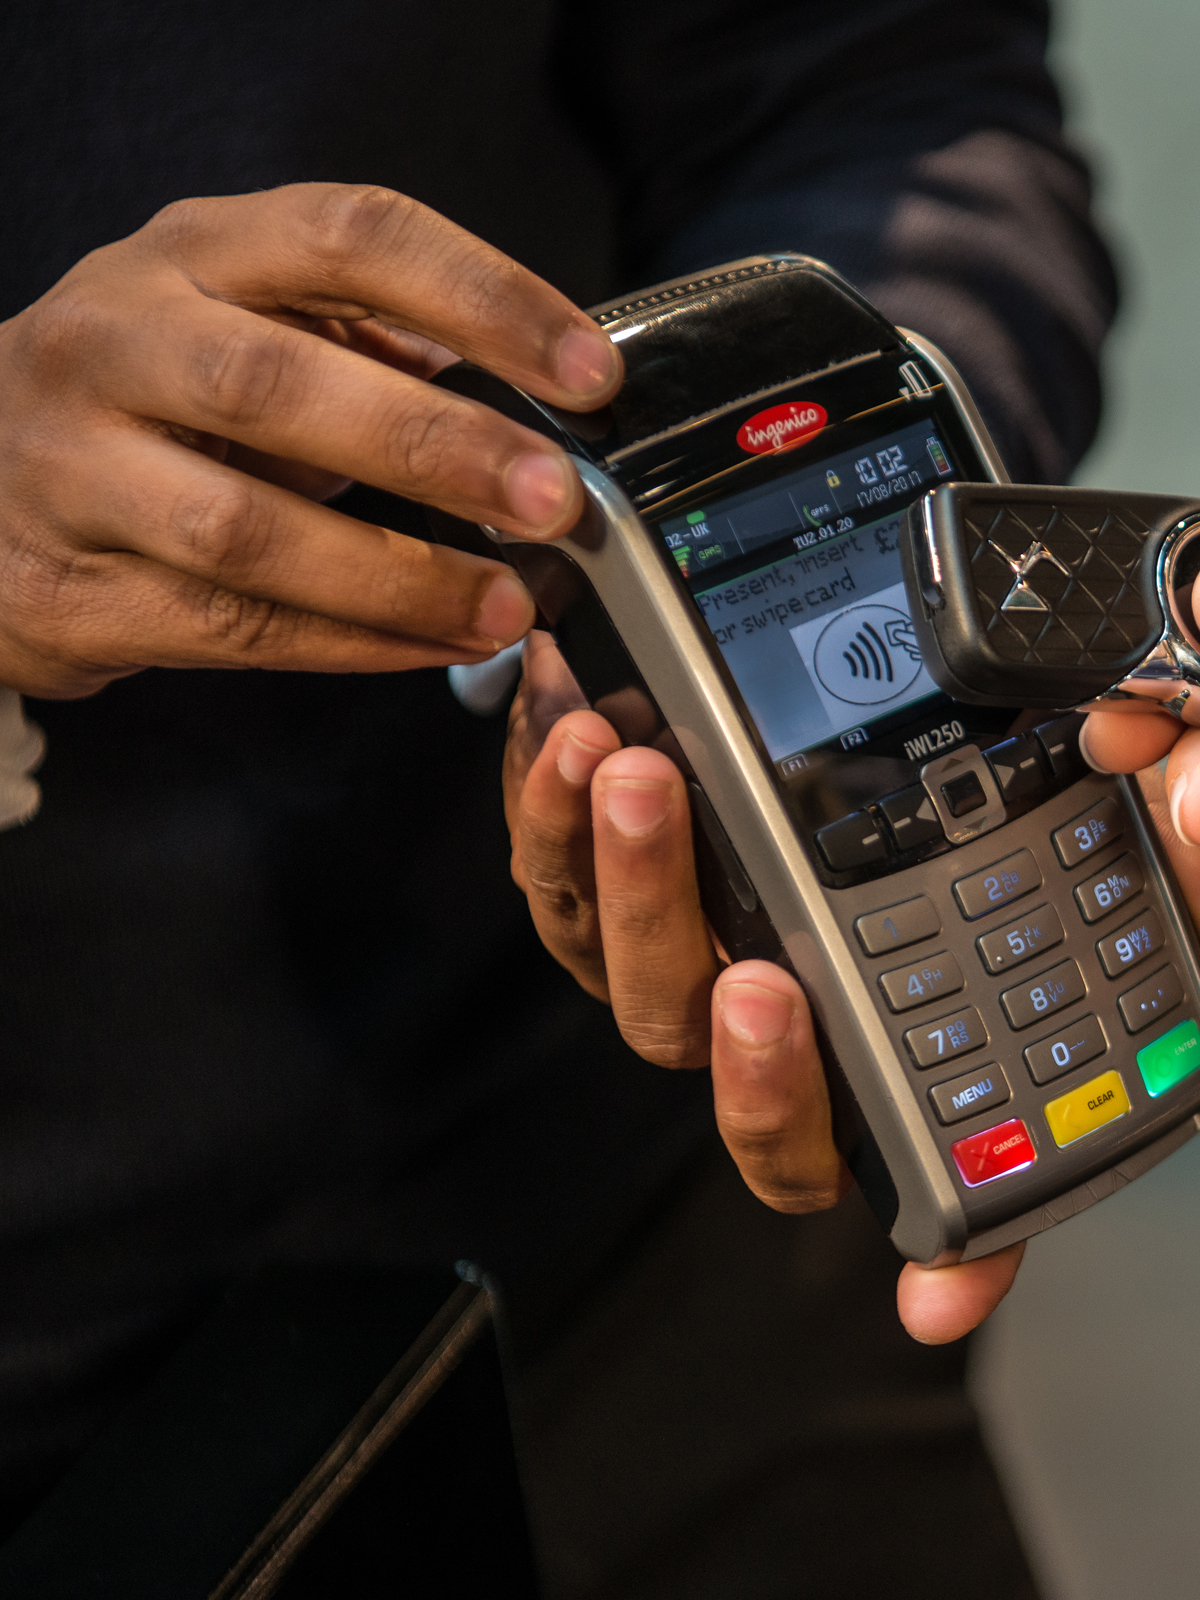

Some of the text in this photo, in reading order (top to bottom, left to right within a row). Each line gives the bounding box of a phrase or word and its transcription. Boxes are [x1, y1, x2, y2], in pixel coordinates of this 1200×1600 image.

[744, 406, 818, 450] ingenico
[795, 534, 864, 574] insert
[712, 566, 857, 646] or swipe card
[903, 720, 966, 762] iWL250
[1074, 826, 1092, 850] 3
[983, 876, 1003, 901] 2
[1093, 882, 1112, 907] 6
[882, 916, 899, 940] 1
[1006, 930, 1026, 956] 5
[1114, 937, 1134, 963] 9
[907, 973, 925, 997] 4
[1029, 986, 1049, 1012] 8
[927, 1028, 945, 1055] 7
[1050, 1041, 1071, 1067] 0
[1174, 1037, 1198, 1056] ENTER
[951, 1078, 994, 1110] MENU
[1086, 1089, 1115, 1111] CLEAR
[992, 1132, 1027, 1156] CANCEL
